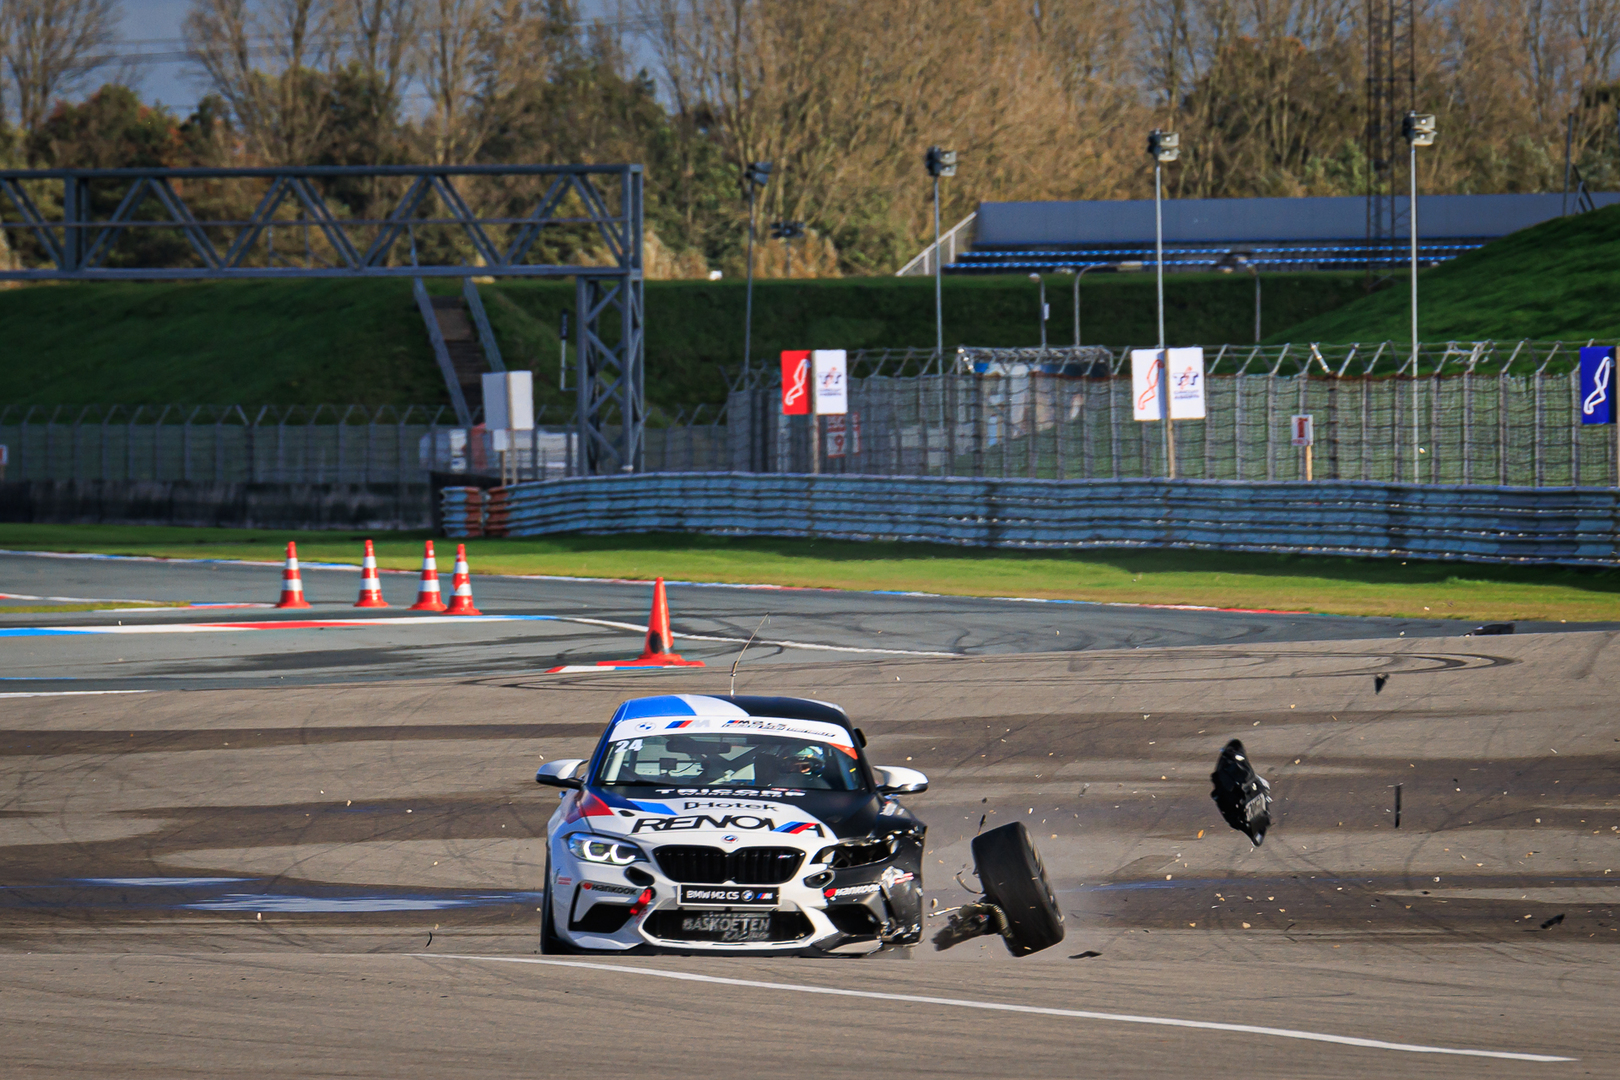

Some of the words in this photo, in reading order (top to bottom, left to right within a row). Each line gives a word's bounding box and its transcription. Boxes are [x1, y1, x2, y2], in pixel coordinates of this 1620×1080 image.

[615, 739, 644, 754] 24
[631, 815, 826, 839] RENOVA
[686, 890, 711, 899] BMW
[711, 890, 725, 900] M2
[726, 891, 740, 900] CS
[682, 917, 771, 932] BASKOETEN
